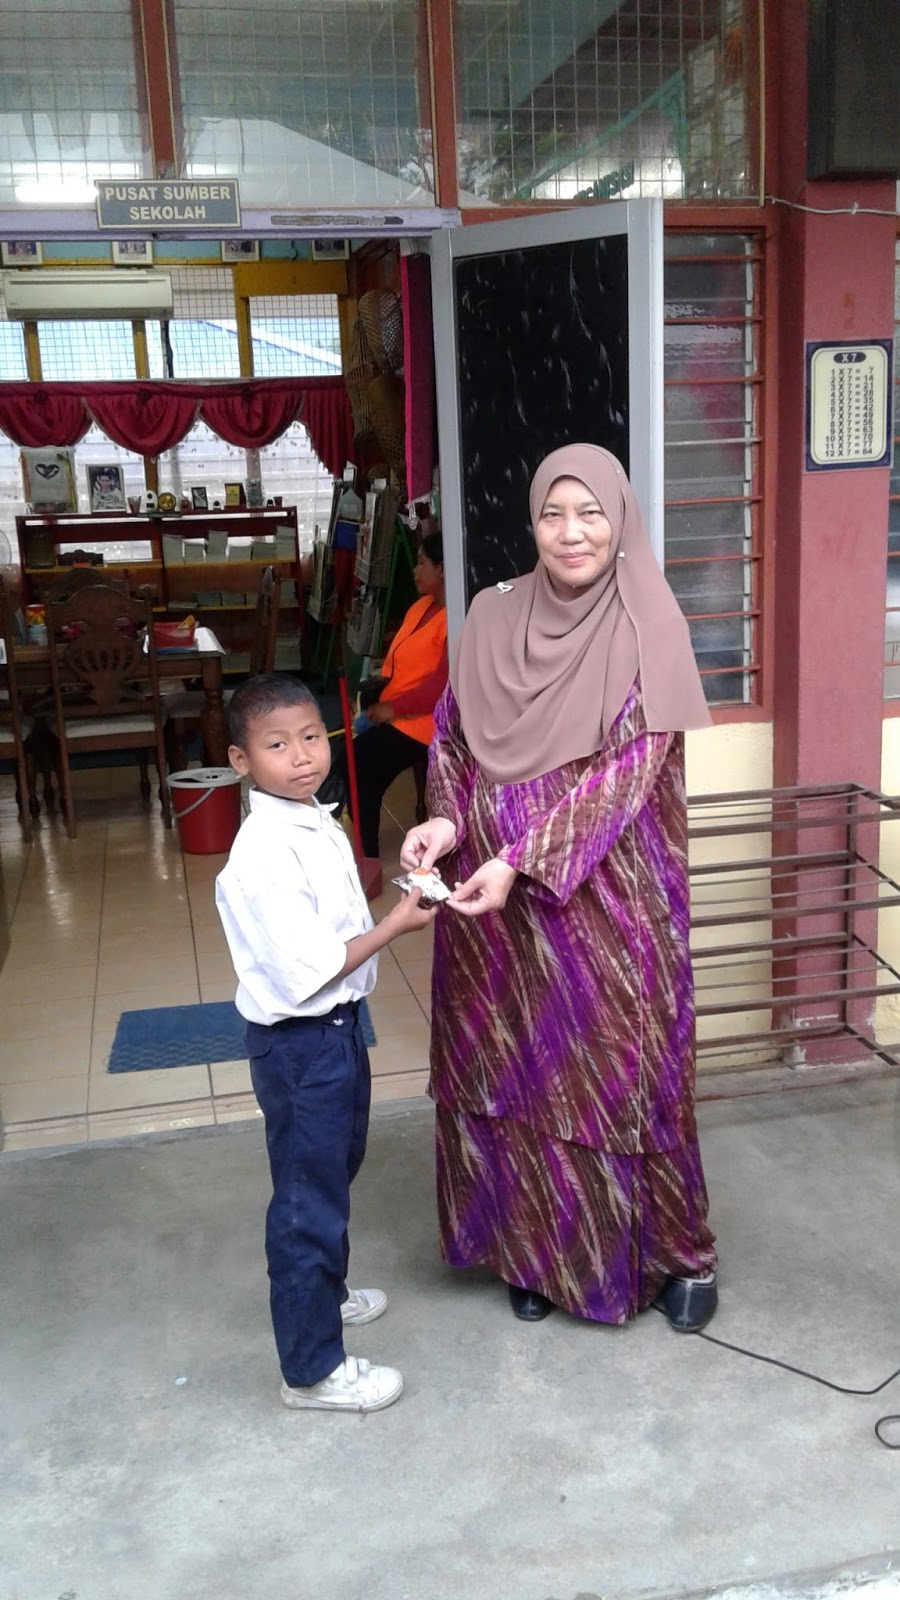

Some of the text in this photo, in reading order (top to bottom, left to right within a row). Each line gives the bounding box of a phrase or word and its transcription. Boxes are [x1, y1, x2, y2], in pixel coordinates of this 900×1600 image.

[105, 186, 231, 200] PUSAT SUMBER
[130, 206, 206, 220] SEKOLAH
[841, 352, 857, 363] X 7
